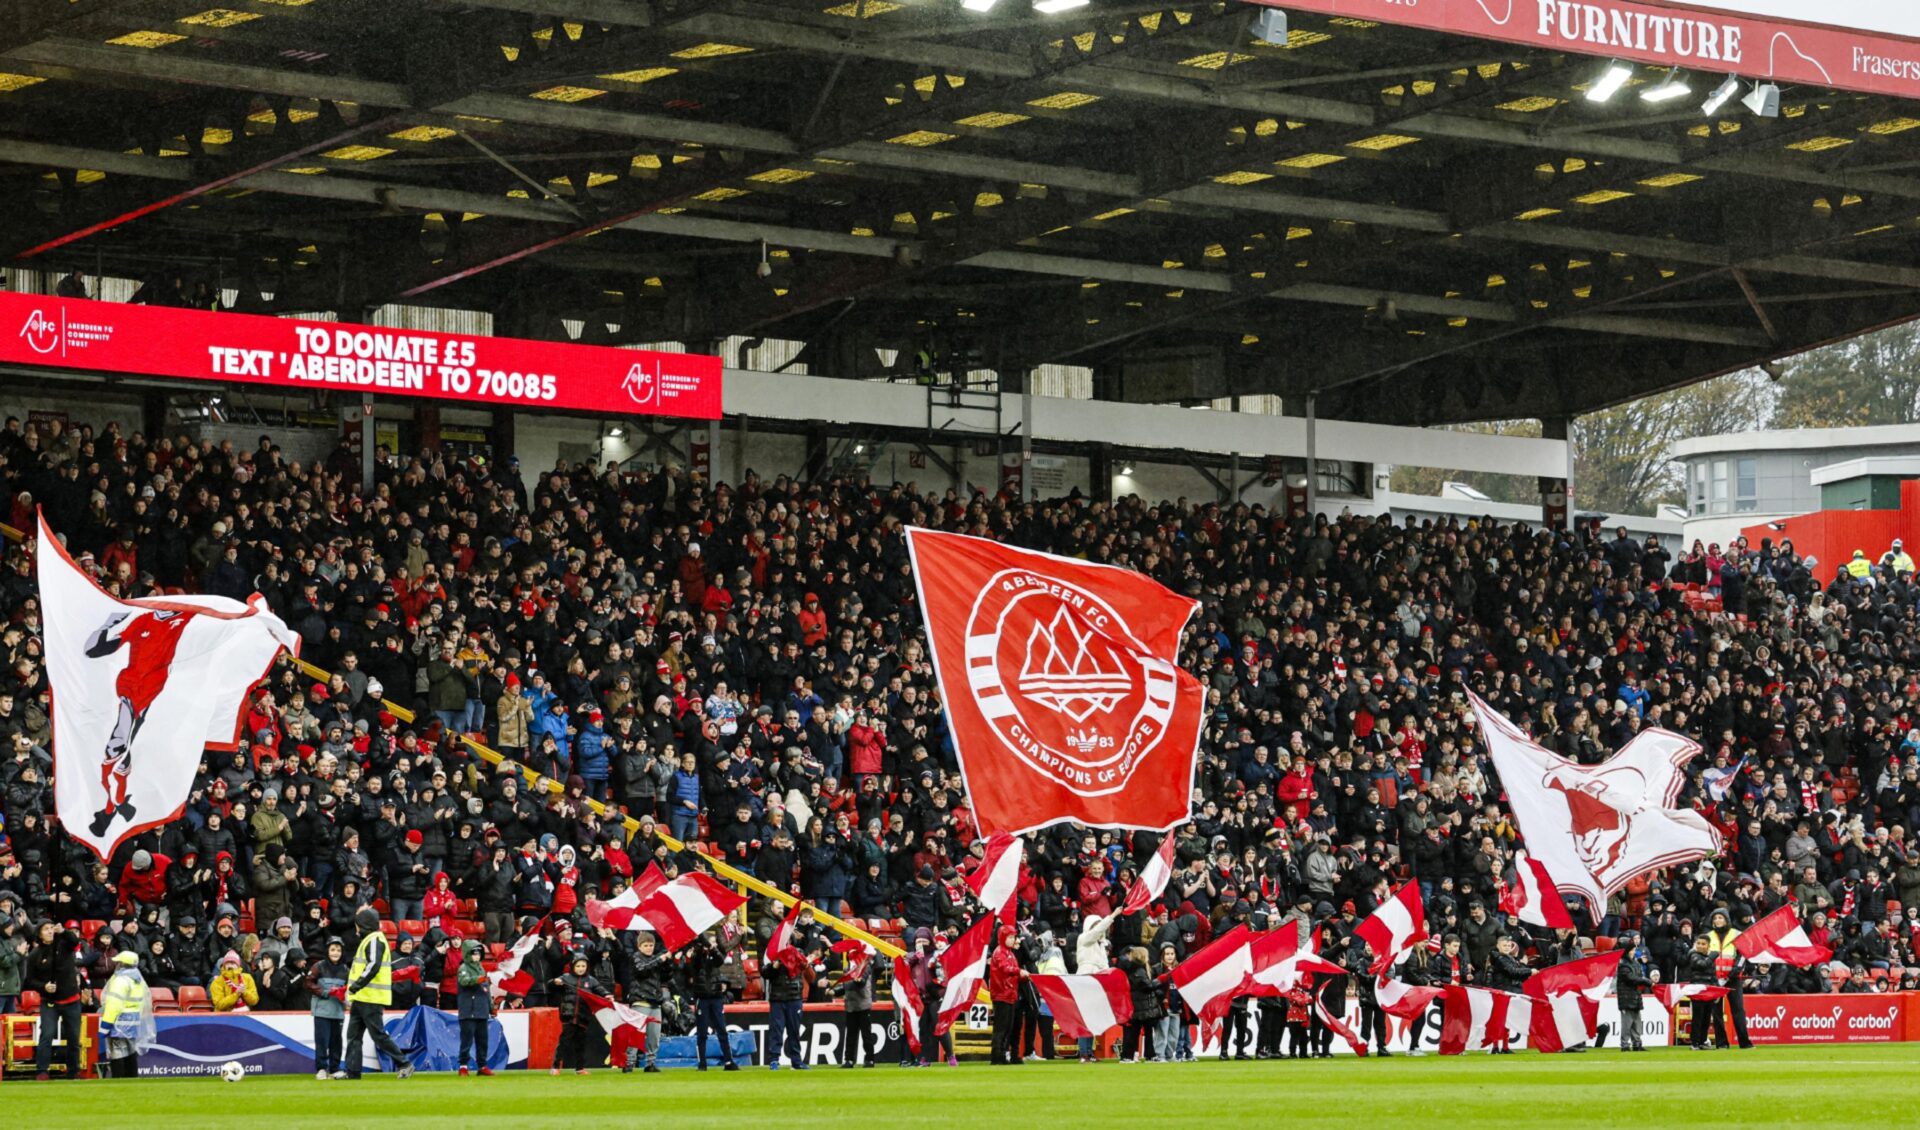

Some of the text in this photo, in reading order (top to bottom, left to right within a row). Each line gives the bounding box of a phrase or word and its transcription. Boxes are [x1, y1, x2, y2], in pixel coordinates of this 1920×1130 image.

[1537, 0, 1742, 63] FURNITURE
[1852, 46, 1920, 80] Frasers
[67, 331, 110, 341] COMMUNITY
[68, 323, 113, 333] ABERDEEN FC
[67, 339, 89, 347] TRUST
[295, 326, 476, 367] TO DONATE £5
[208, 346, 557, 400] TEXT 'ABERDEEN' TO 70085
[661, 374, 691, 383] ABERDEEN
[661, 382, 697, 391] COMMUNITY
[661, 389, 679, 397] TRUST
[364, 404, 373, 416] V
[1023, 450, 1031, 460] W
[1003, 575, 1108, 628] ABERDEEN FC
[1010, 722, 1154, 785] CHAMPIONS OF EUROPE
[971, 1005, 988, 1022] 22
[1745, 1012, 1779, 1029] arbon
[1791, 1012, 1836, 1029] carbon
[1848, 1012, 1891, 1029] carbon
